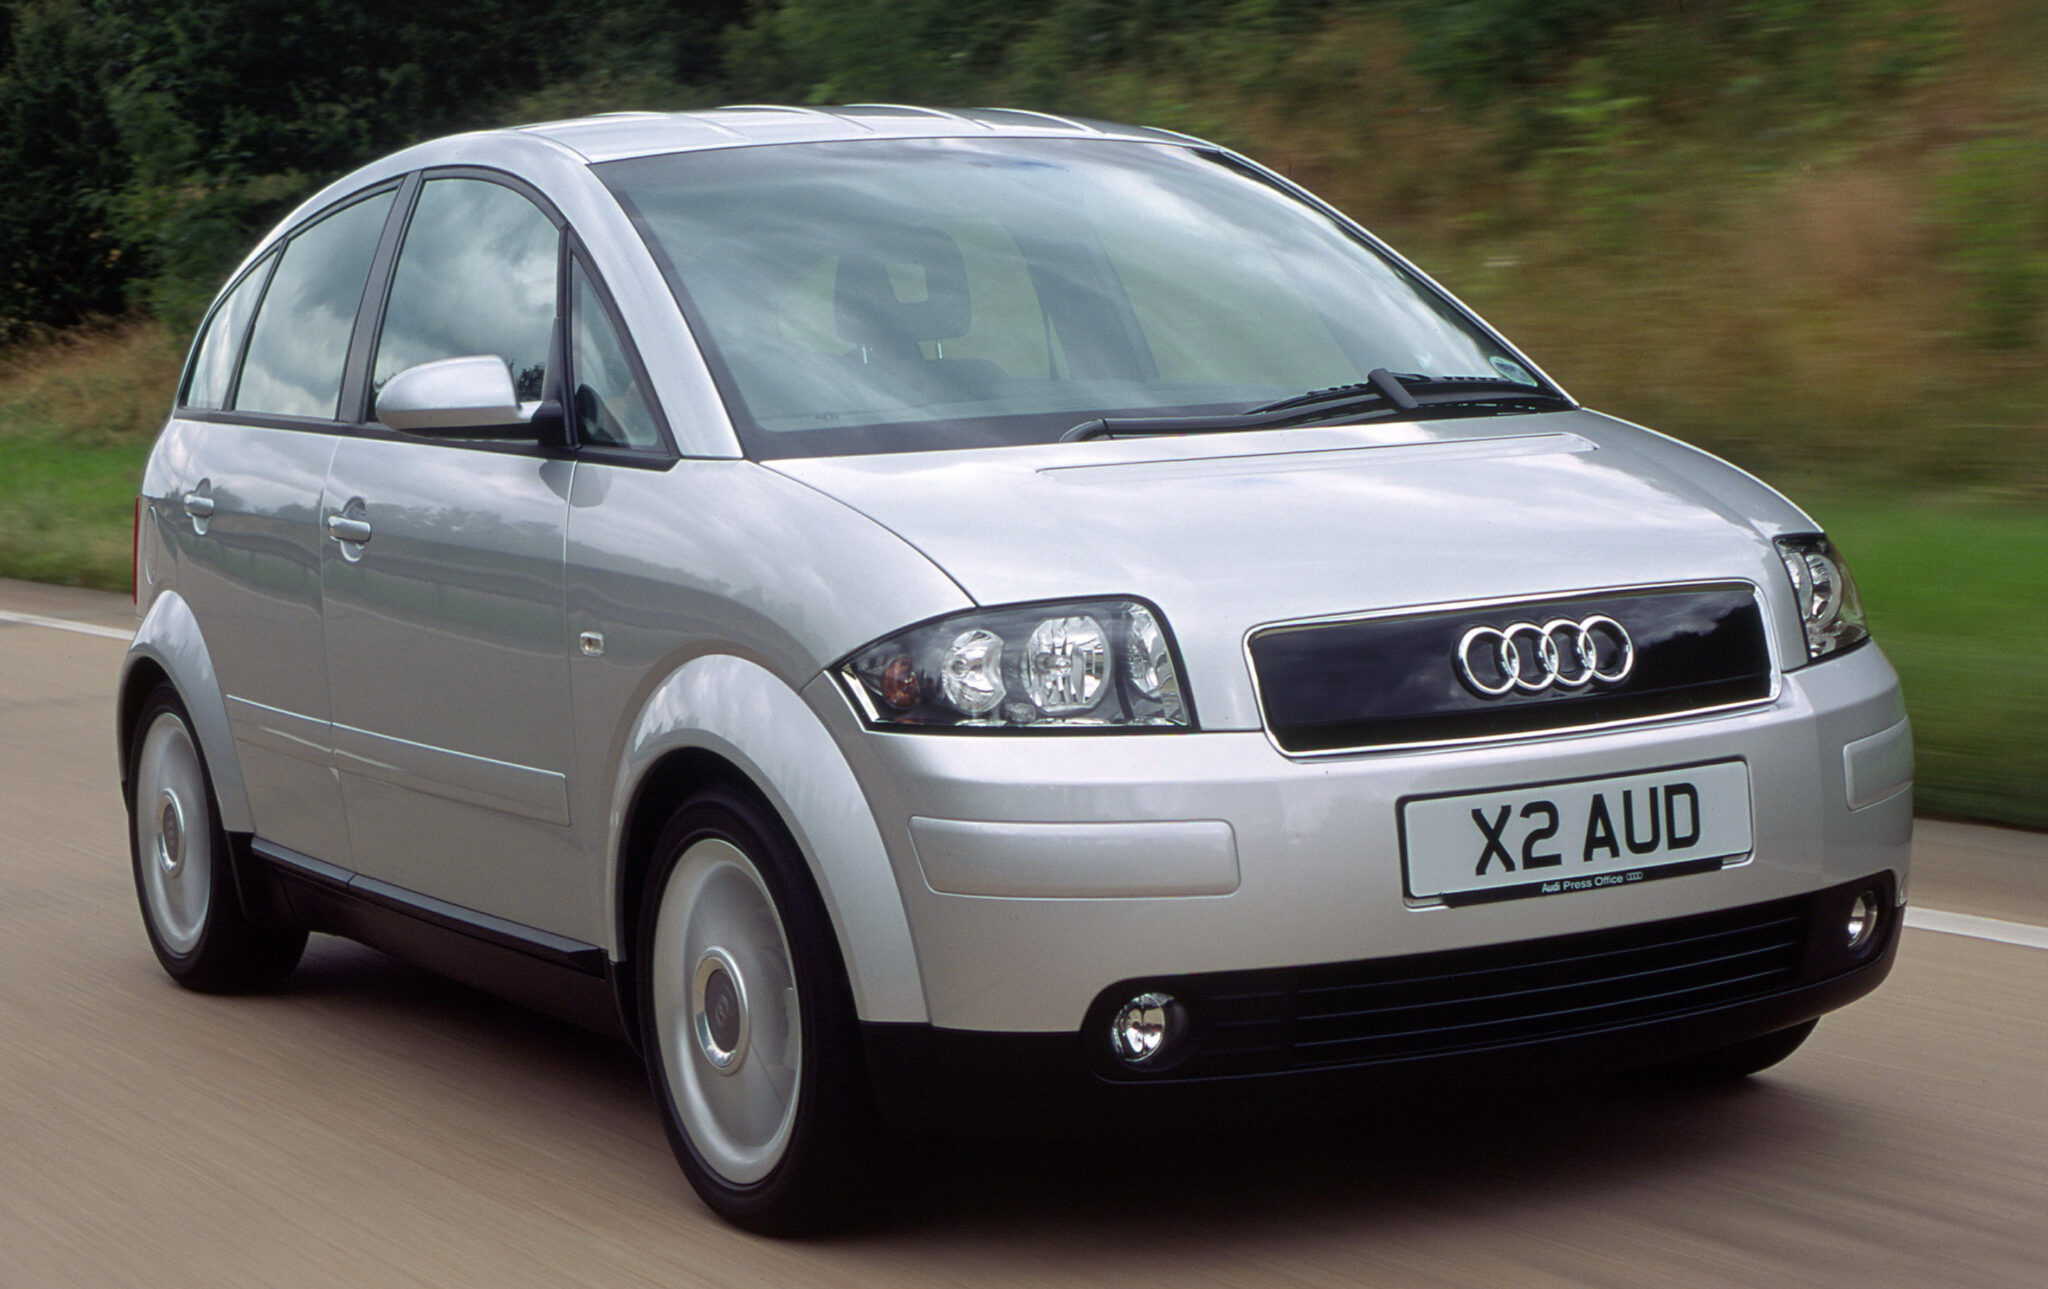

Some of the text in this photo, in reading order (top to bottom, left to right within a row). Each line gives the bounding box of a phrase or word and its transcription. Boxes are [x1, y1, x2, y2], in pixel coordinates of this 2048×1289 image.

[1471, 782, 1700, 876] X2 AUD
[1541, 874, 1624, 893] Audi Press Office
